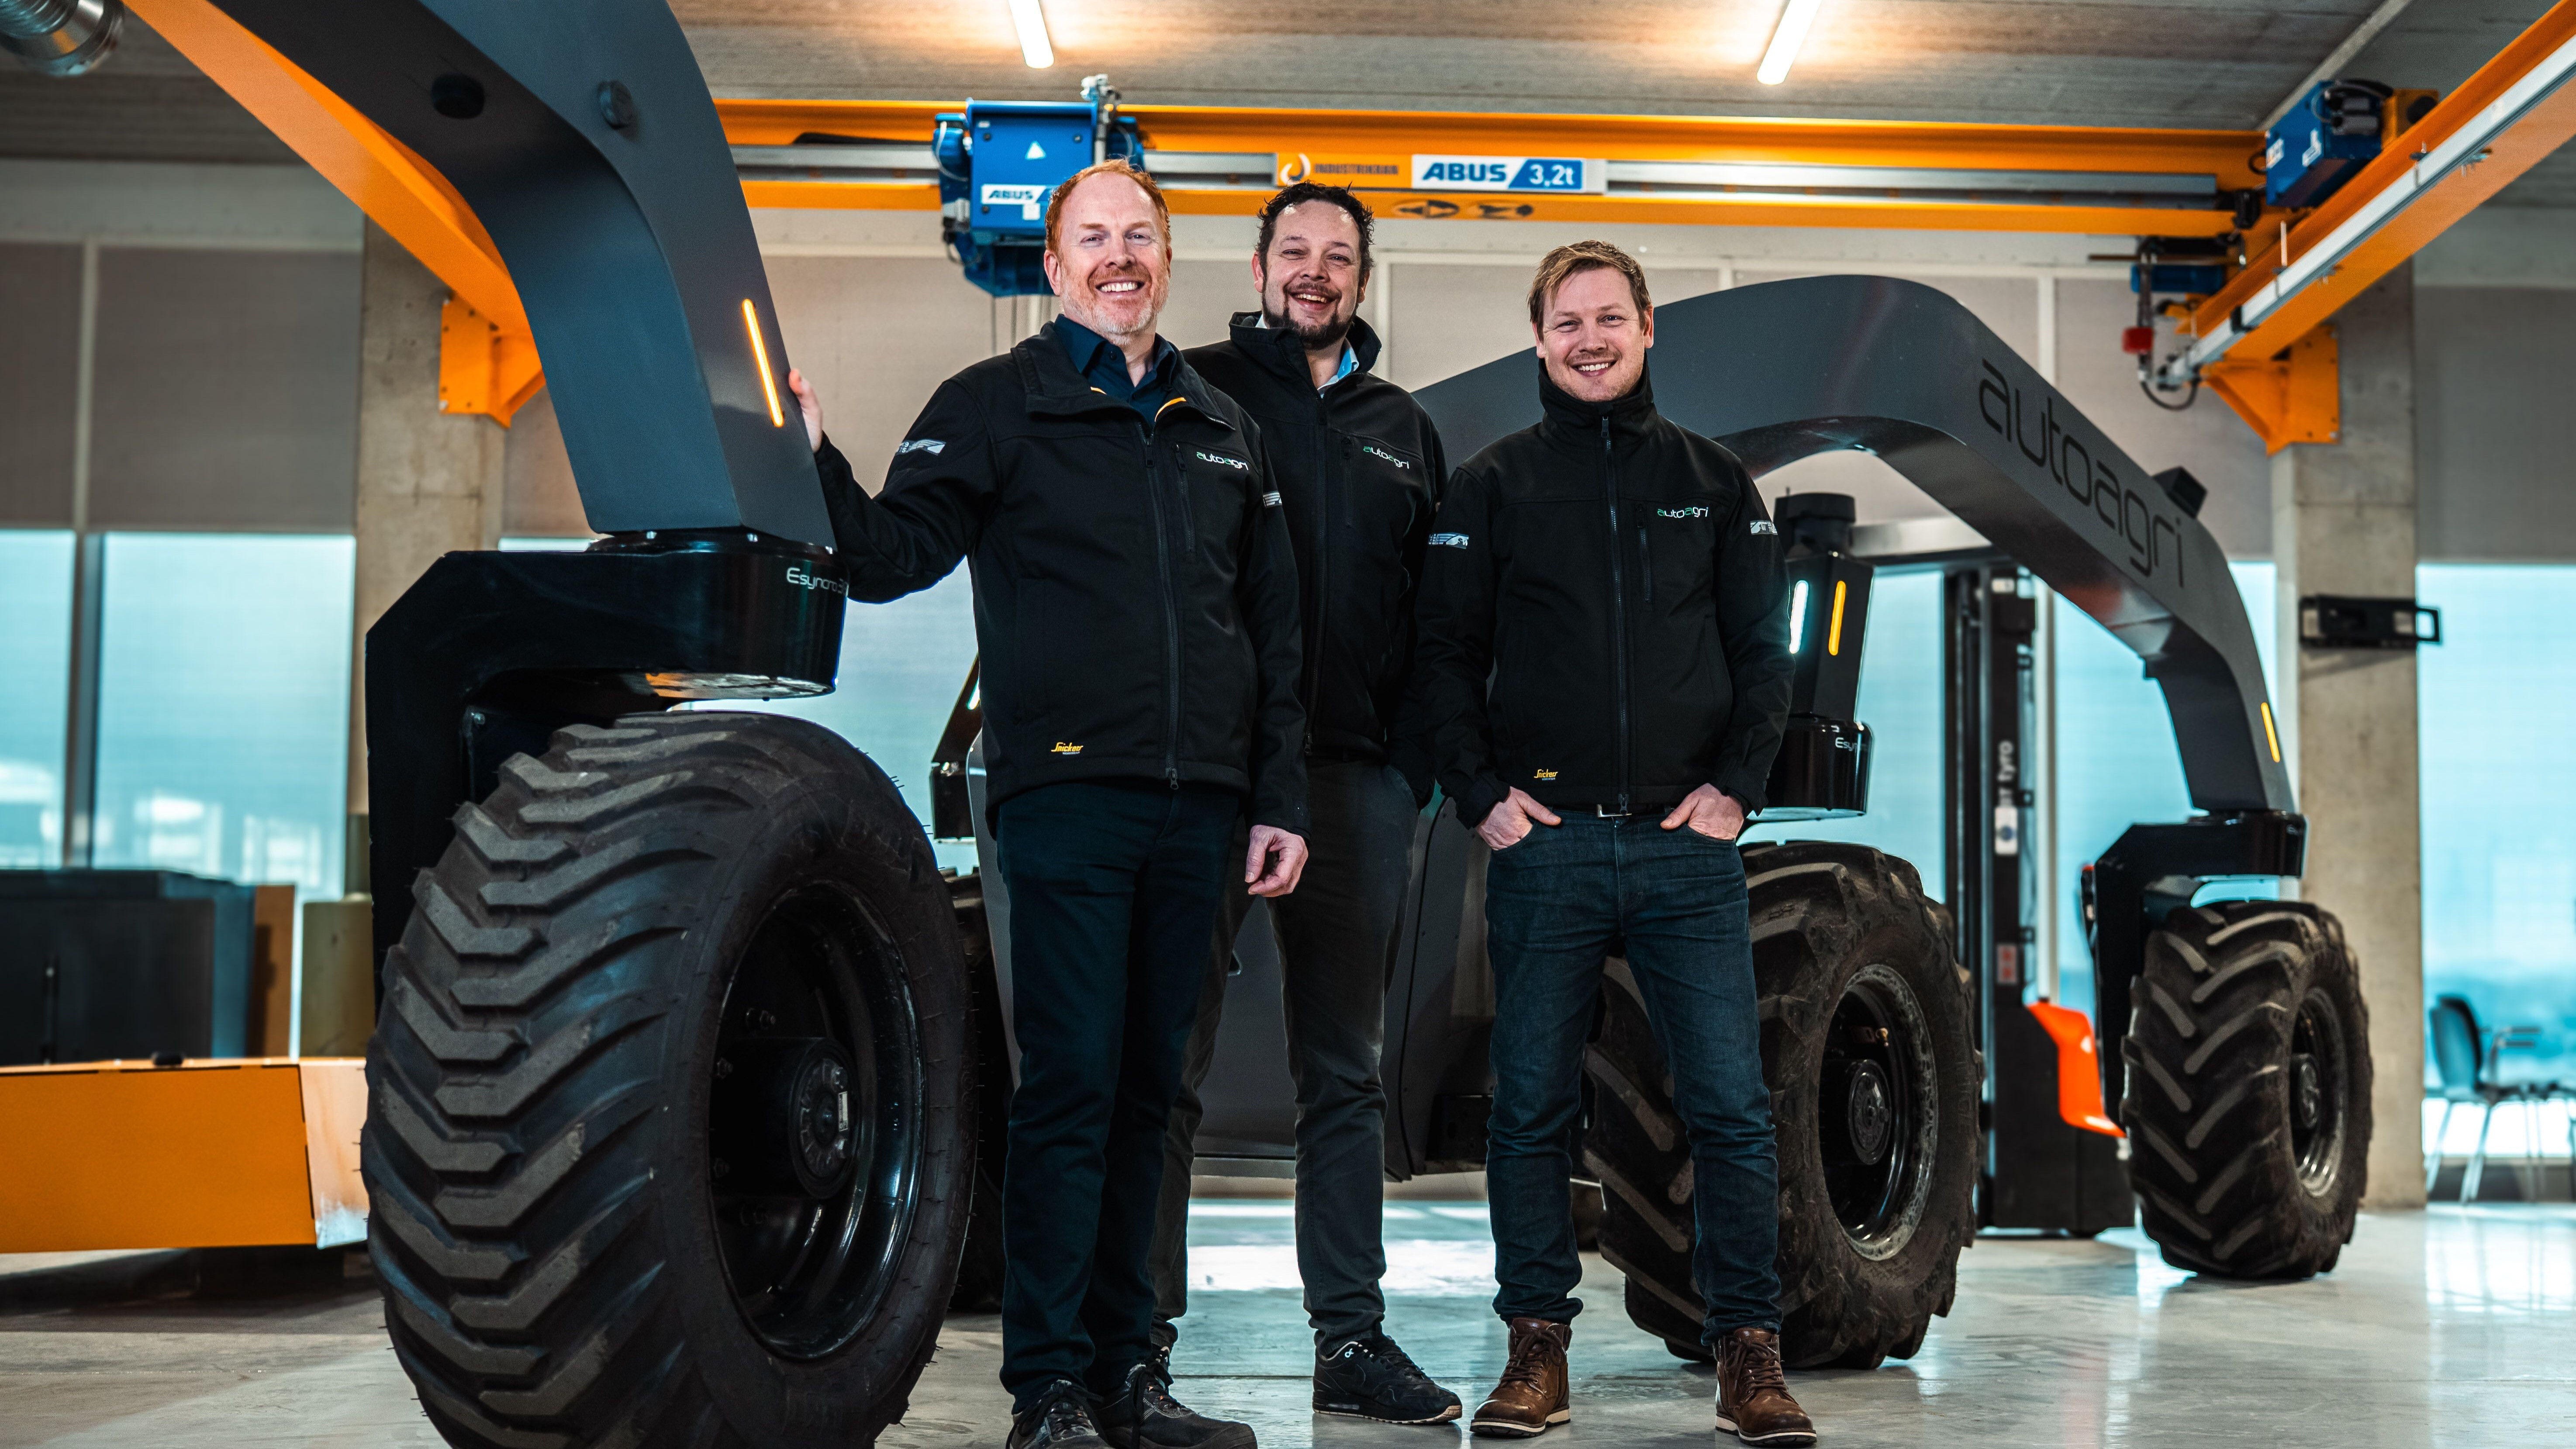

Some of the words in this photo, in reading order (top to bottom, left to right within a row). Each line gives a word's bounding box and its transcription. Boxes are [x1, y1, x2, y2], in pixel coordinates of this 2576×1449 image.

[1422, 162, 1507, 182] ABUS
[1530, 164, 1575, 187] 3,2t
[988, 190, 1034, 200] ABUS
[1196, 452, 1249, 471] autoagri
[1363, 446, 1409, 469] autoagri
[1979, 358, 2183, 588] autoagri
[1657, 507, 1709, 518] autoagri
